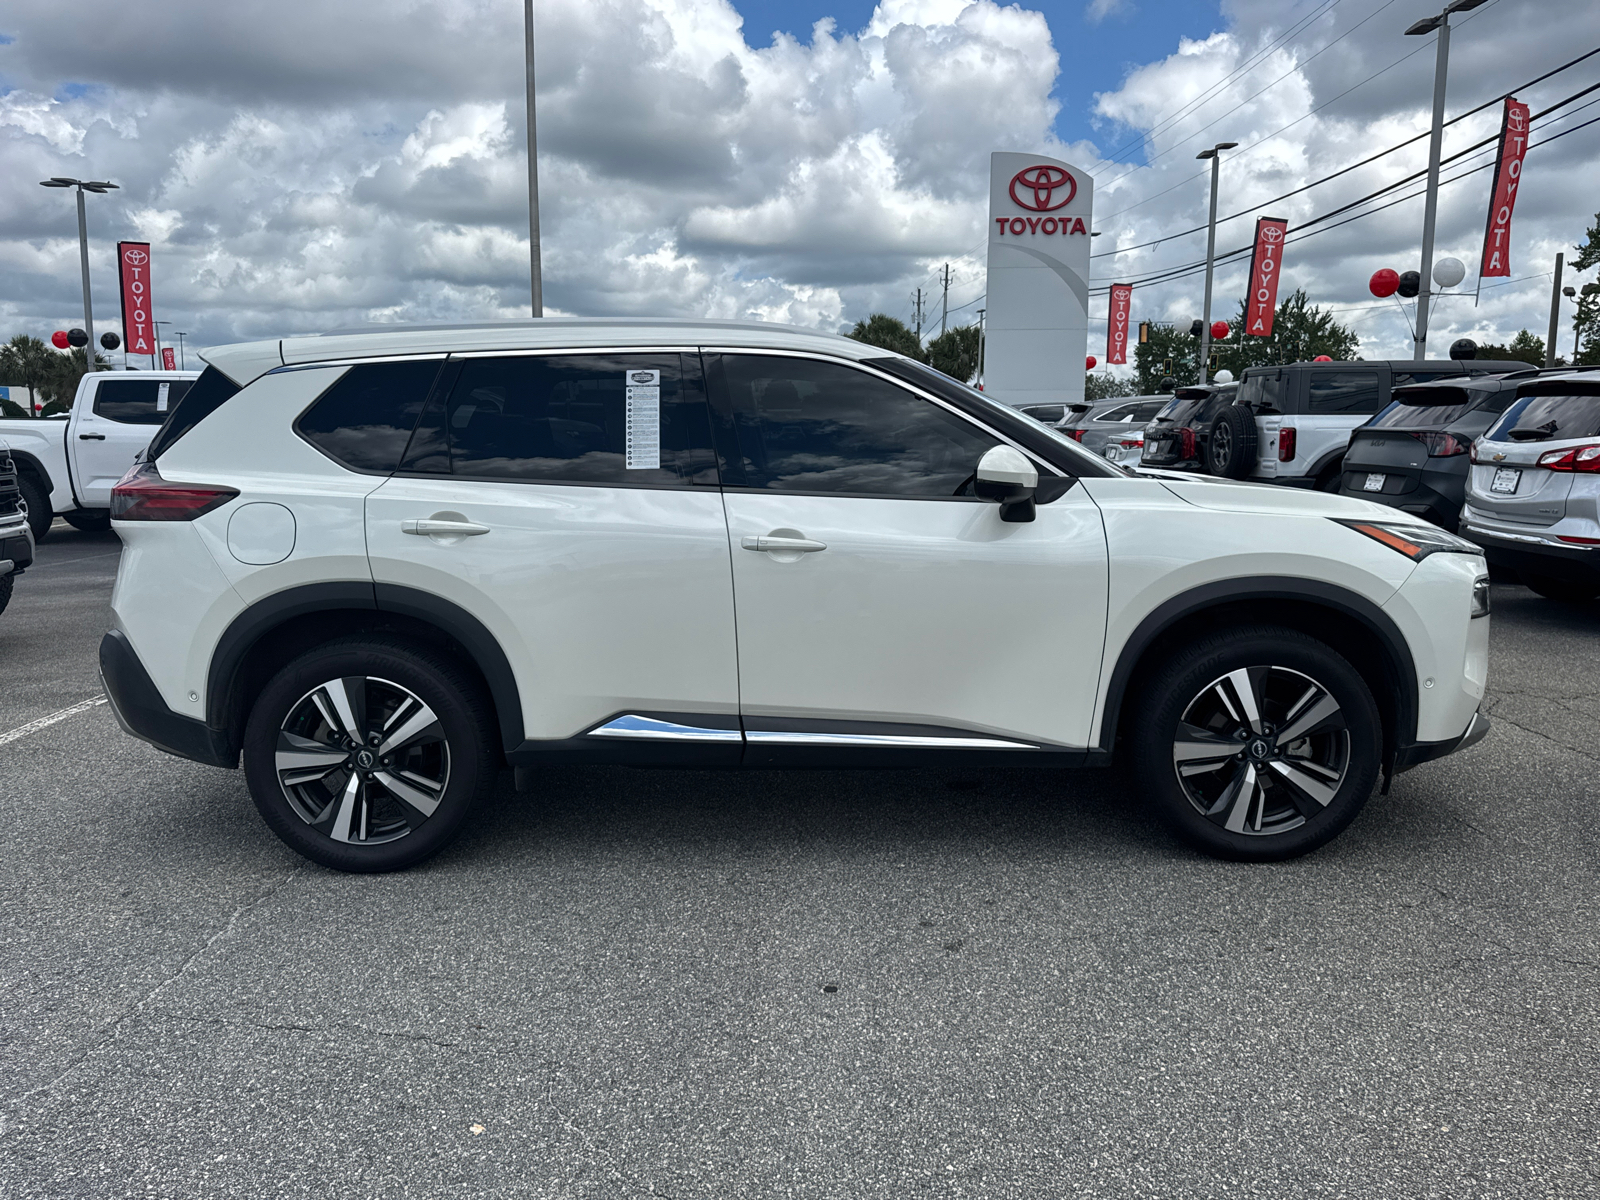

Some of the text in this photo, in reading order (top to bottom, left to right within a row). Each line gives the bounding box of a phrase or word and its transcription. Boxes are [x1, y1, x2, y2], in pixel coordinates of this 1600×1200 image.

[995, 217, 1087, 236] TOYOTA
[1489, 137, 1524, 270] TOYOTA
[131, 267, 149, 350] TOYOTA
[1252, 245, 1276, 331] TOYOTA
[1113, 301, 1126, 362] TOYOTA
